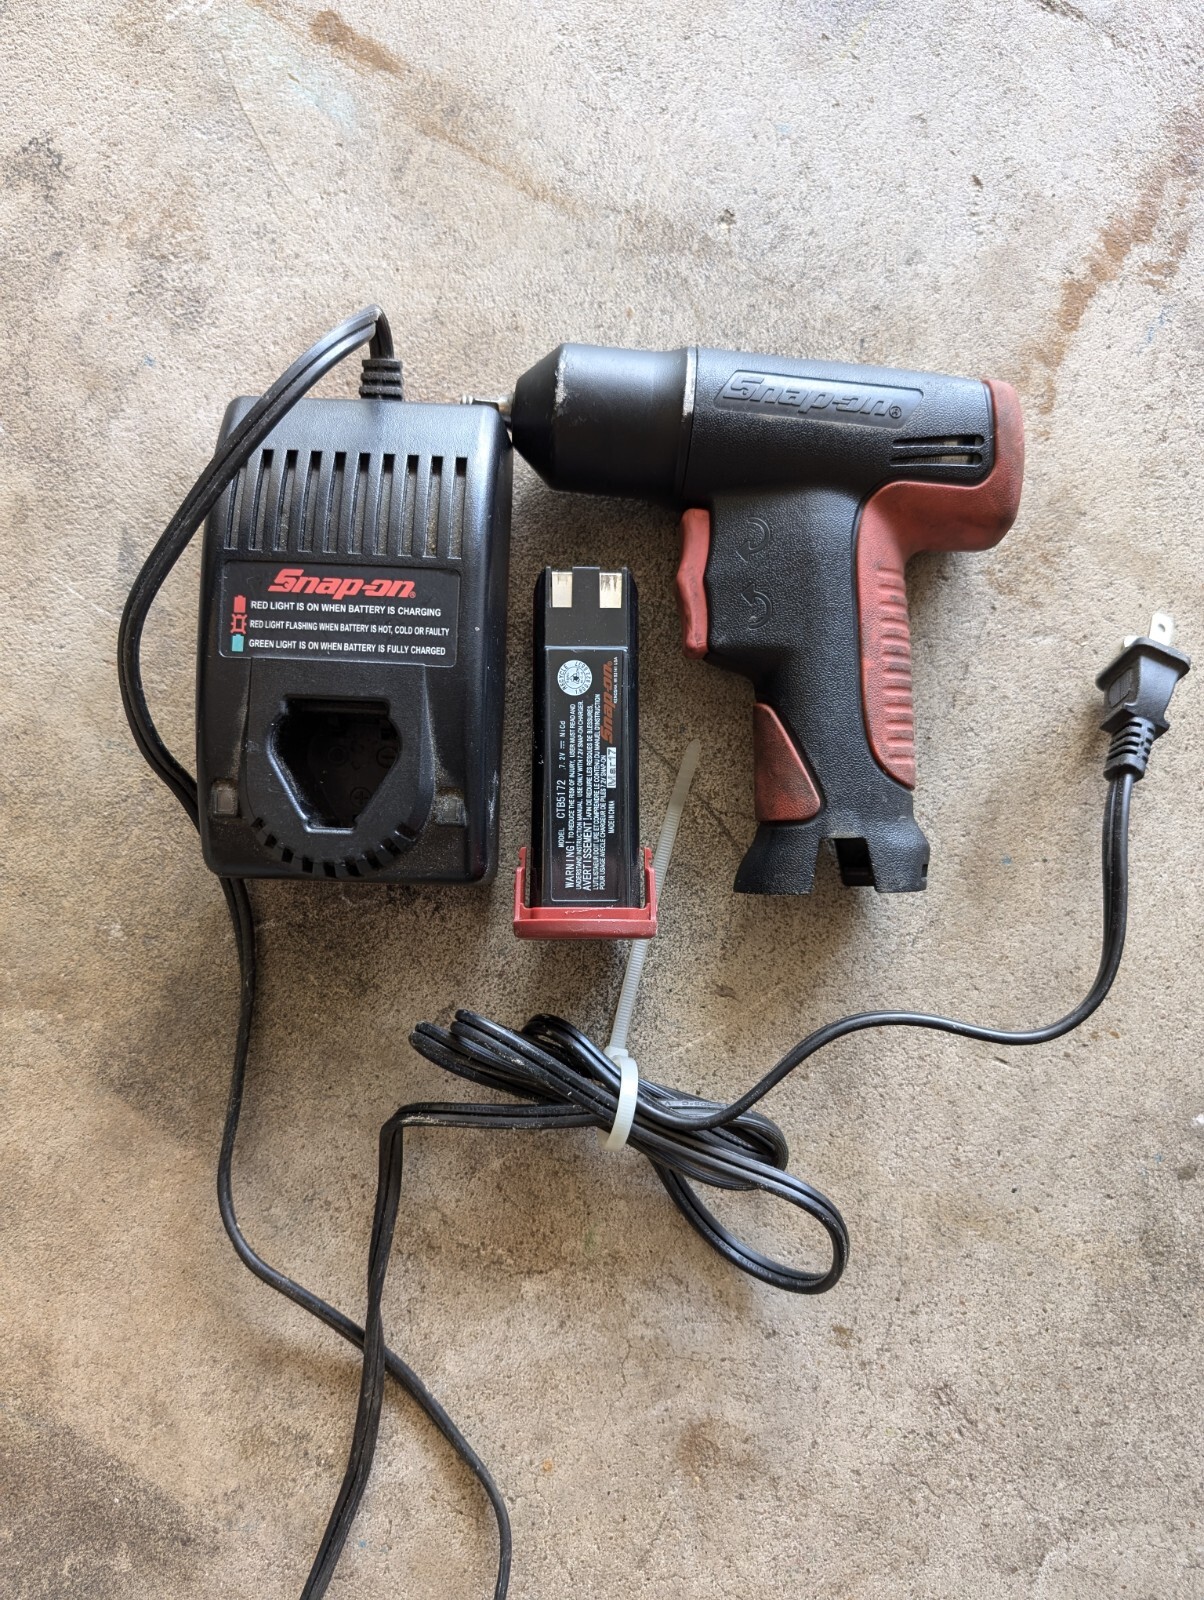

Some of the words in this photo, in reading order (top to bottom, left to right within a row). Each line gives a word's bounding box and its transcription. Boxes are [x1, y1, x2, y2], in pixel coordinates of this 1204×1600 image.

[251, 600, 268, 610] RED
[270, 601, 295, 611] LIGHT
[296, 602, 304, 611] IS
[307, 602, 319, 612] ON
[321, 603, 346, 613] WHEN
[348, 604, 385, 615] BATTERY
[387, 606, 395, 615] IS
[397, 606, 441, 617] CHARGING
[249, 620, 264, 629] RED
[265, 620, 284, 630] LIGHT
[285, 621, 318, 631] FLASHING
[319, 622, 339, 632] WHEN
[340, 623, 369, 633] BATTERY
[370, 624, 377, 633] IS
[378, 624, 393, 636] HOT,
[394, 625, 413, 635] COLD
[414, 626, 424, 635] OR
[425, 626, 449, 636] FAULTY
[249, 639, 274, 649] GREEN
[276, 640, 297, 650] LIGHT
[299, 641, 306, 650] IS
[308, 641, 319, 651] ON
[320, 642, 342, 652] WHEN
[344, 643, 376, 653] BATTERY
[378, 644, 385, 653] IS
[387, 644, 409, 654] FULLY
[410, 645, 446, 656] CHARGED
[556, 779, 566, 819] CTB5172
